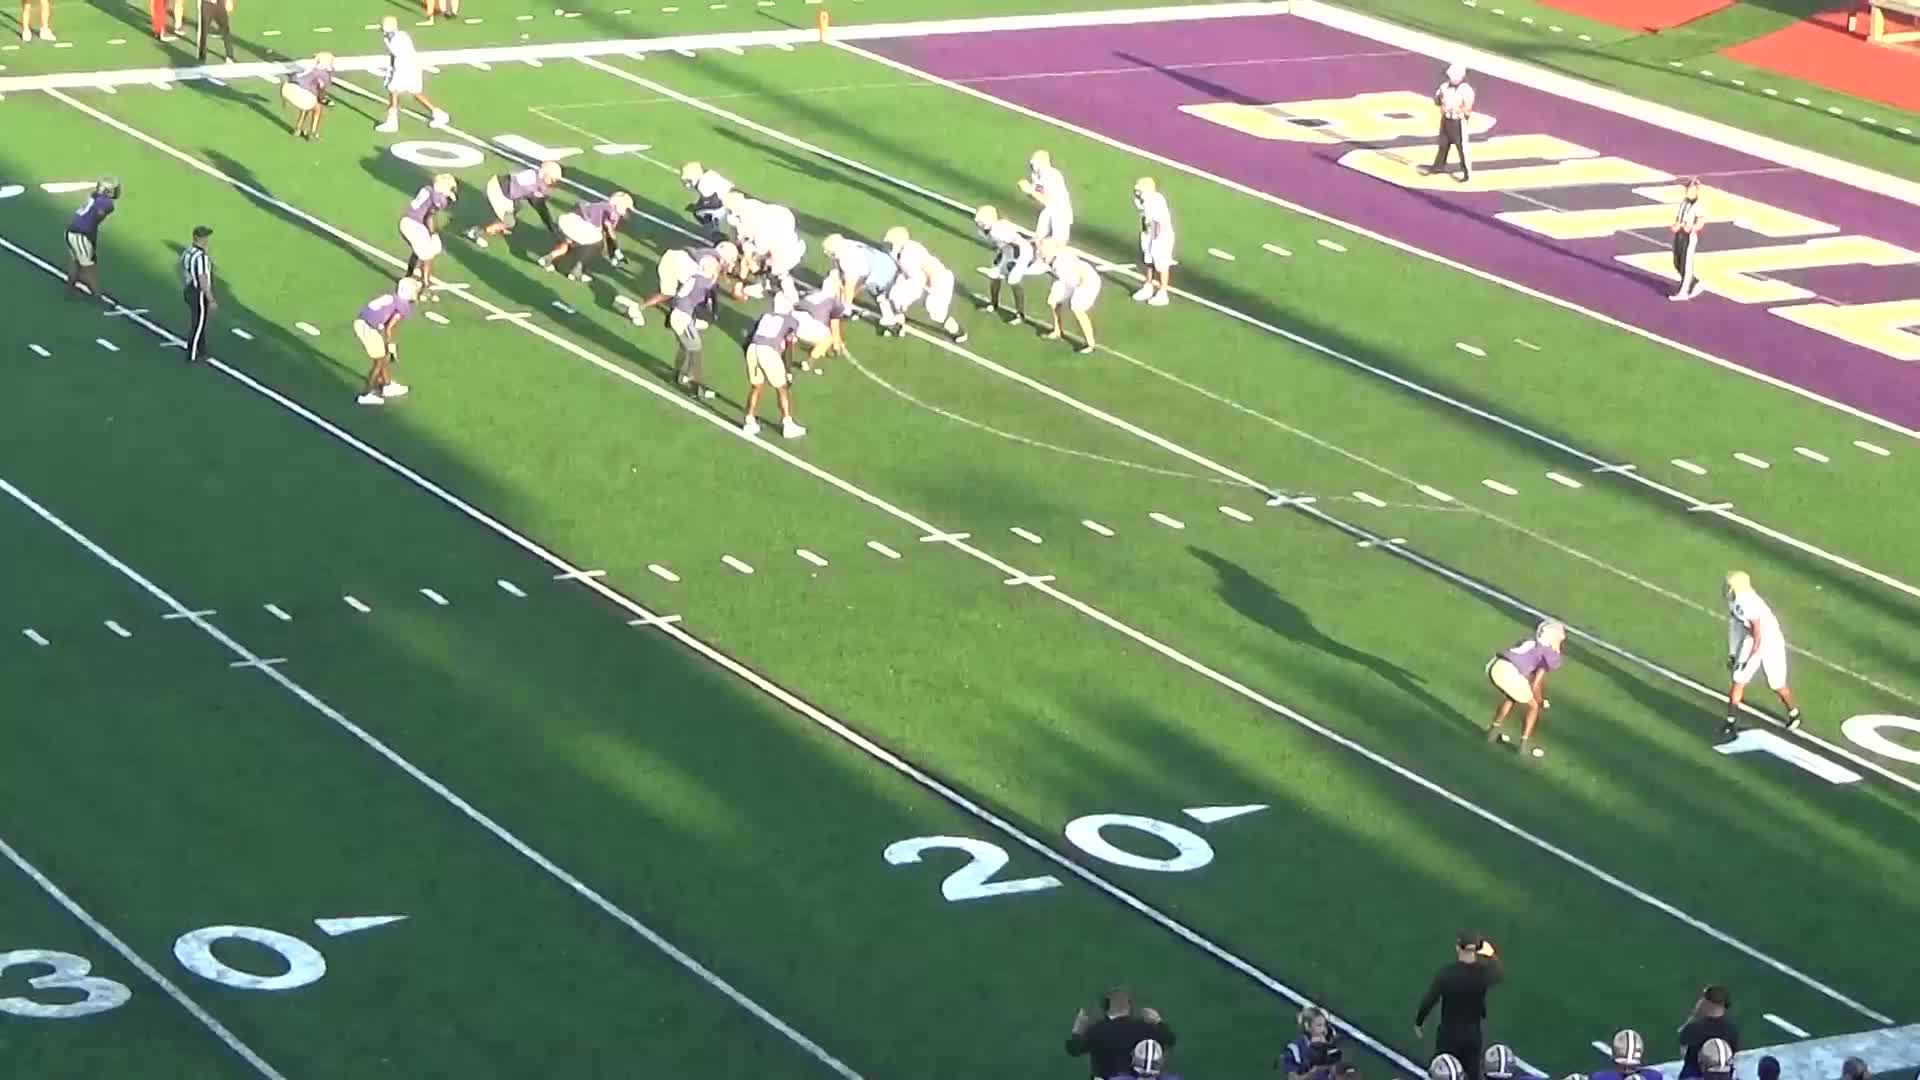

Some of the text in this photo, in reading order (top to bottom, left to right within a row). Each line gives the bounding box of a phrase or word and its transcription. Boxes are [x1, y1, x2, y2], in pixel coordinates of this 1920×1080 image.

[390, 134, 584, 168] 10
[883, 813, 1214, 901] 20
[0, 925, 326, 1018] 30
